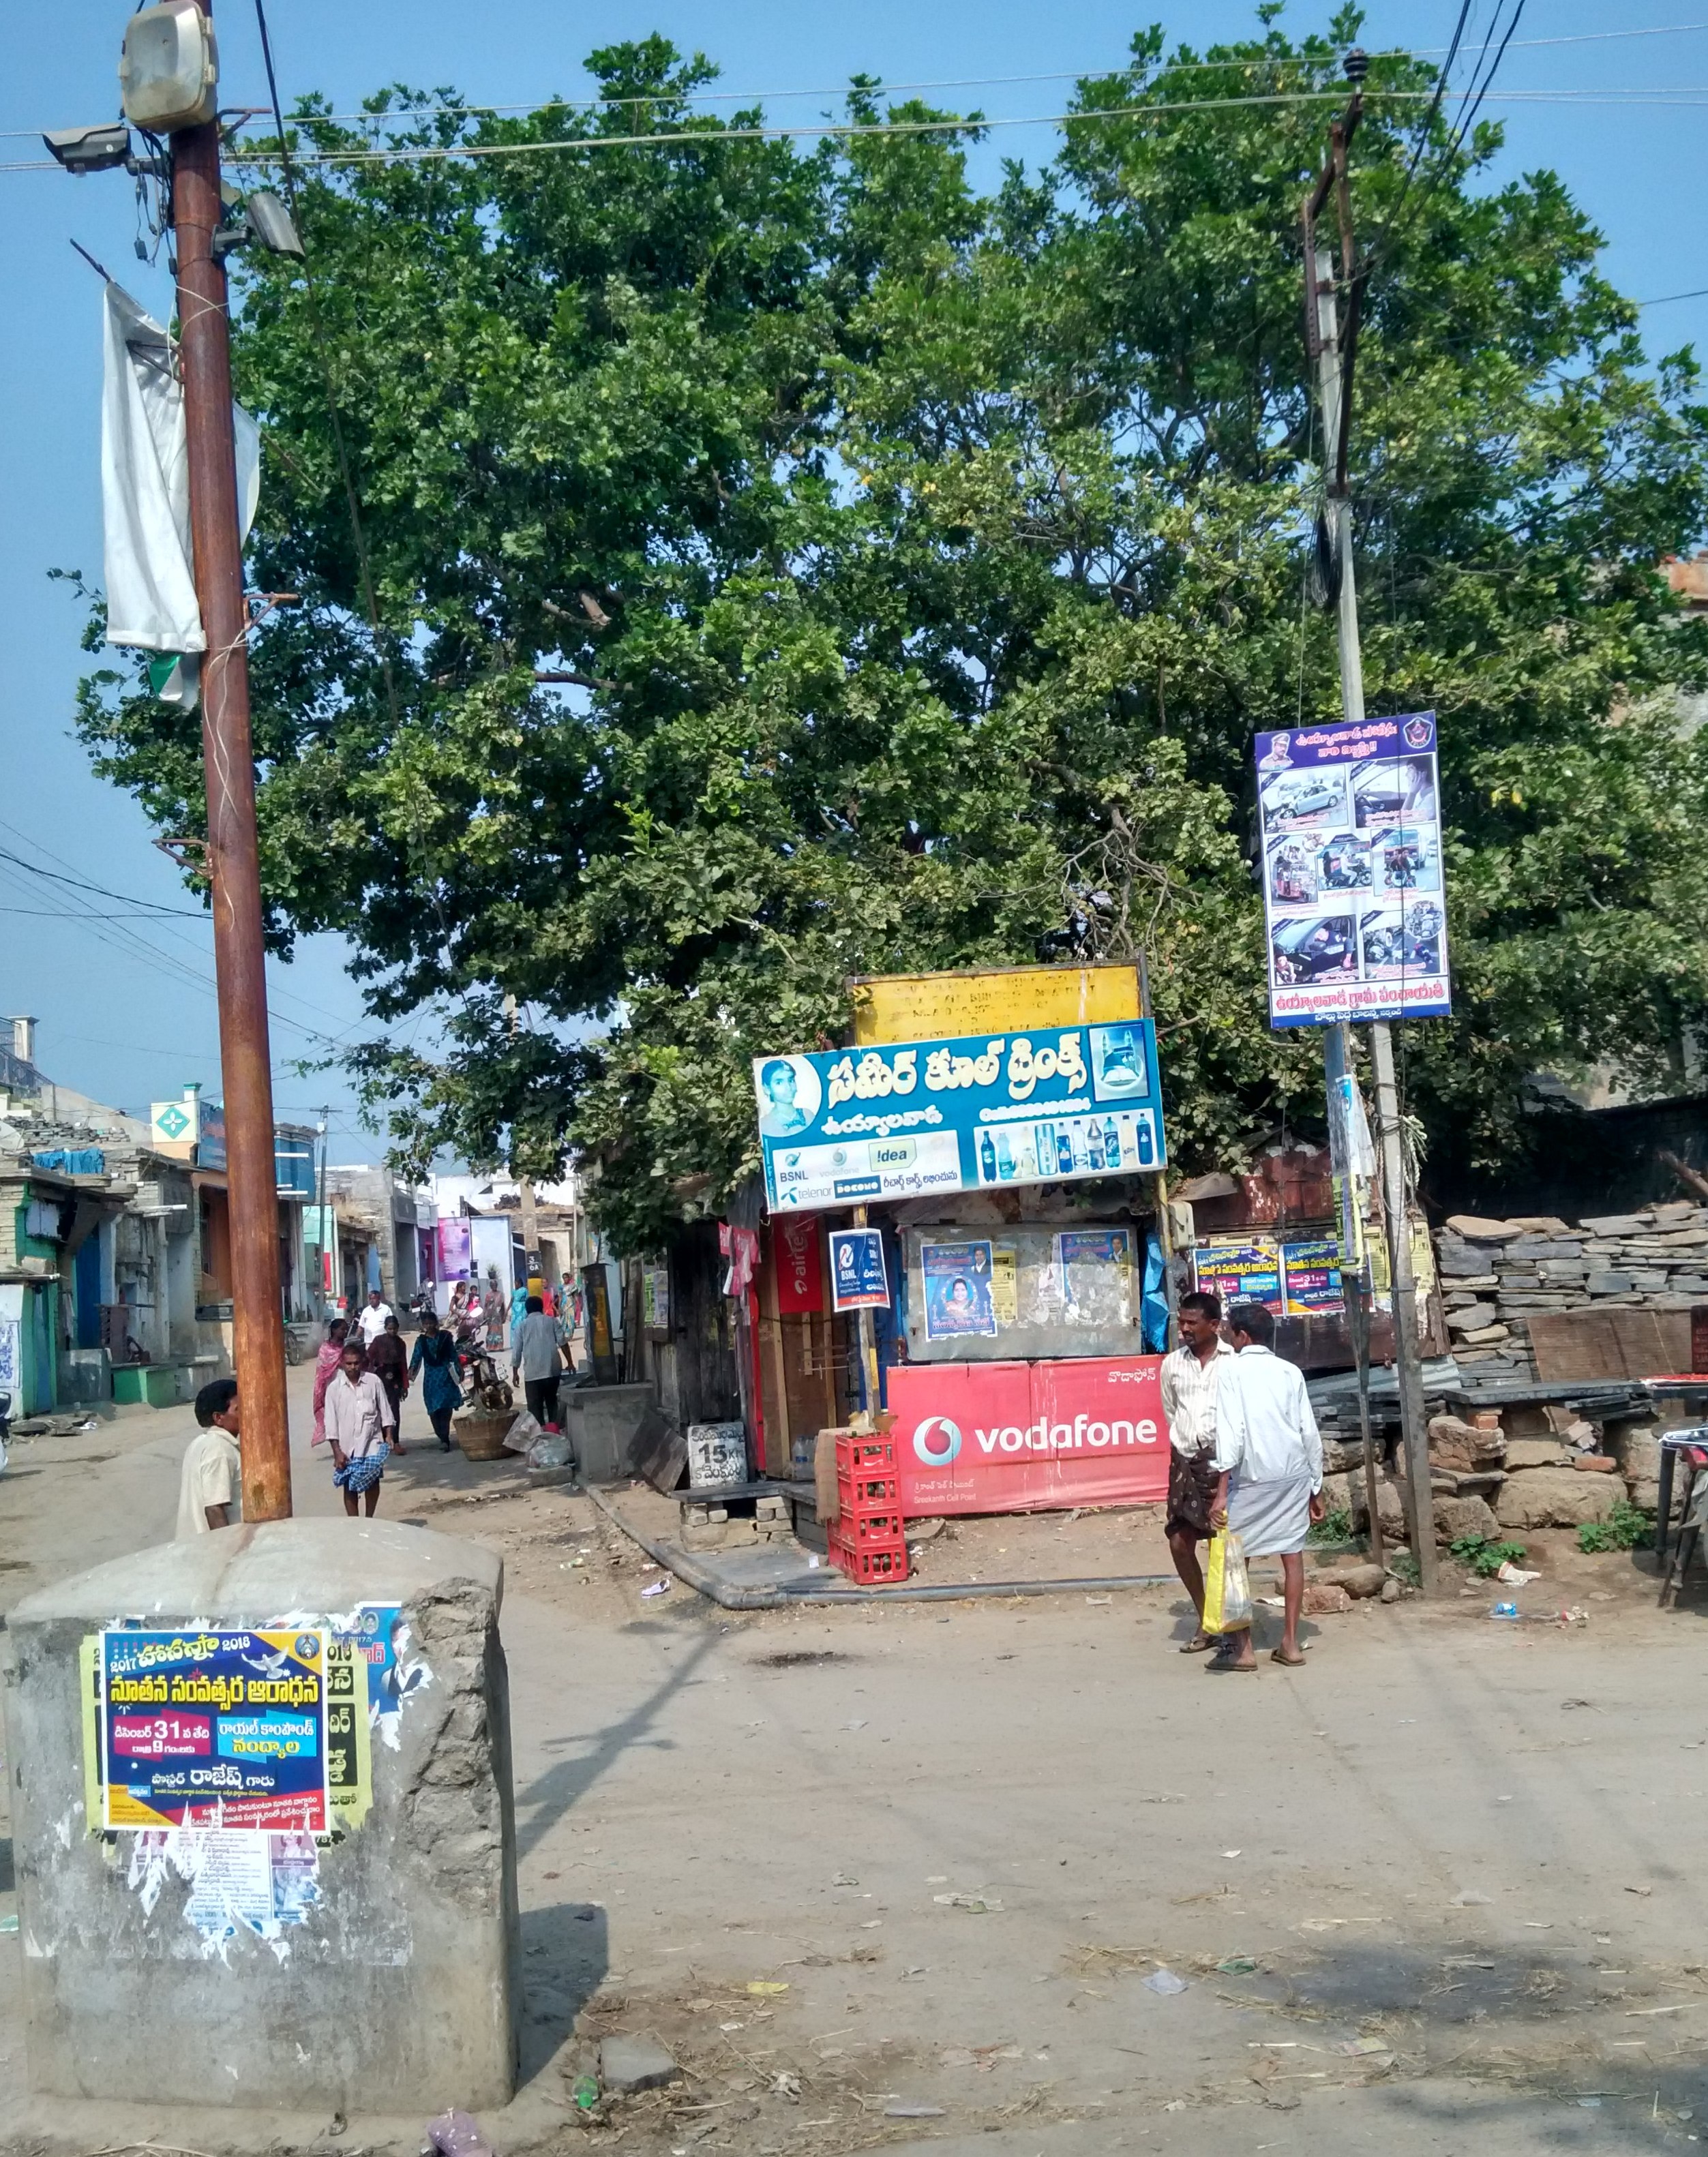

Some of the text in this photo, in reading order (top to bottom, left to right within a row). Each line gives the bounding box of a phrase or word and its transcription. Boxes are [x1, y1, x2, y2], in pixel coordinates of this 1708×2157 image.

[1276, 991, 1347, 1012] ఉయ్యాలవాడ
[1349, 987, 1377, 1008] గ్రామ
[826, 1048, 918, 1110] సమీర్
[924, 1038, 1006, 1092] కూల్
[821, 1104, 943, 1136] ఉయ్యాలవాడ
[780, 1171, 809, 1183] BSNL
[820, 1166, 859, 1177] vodafone
[798, 1187, 832, 1199] telenor
[837, 1181, 878, 1194] DOCOMO
[841, 1269, 857, 1280] BSNL
[975, 1414, 1157, 1453] vodafone
[699, 1443, 728, 1463] 15
[914, 1493, 976, 1504] Sreekanth Cell Point
[110, 1658, 136, 1673] 2017
[222, 1636, 250, 1652] 2018
[327, 1644, 352, 1661] 018
[110, 1675, 319, 1711] నూతన సంవత్సర ఆరాధన
[114, 1725, 152, 1739] డిసెంబర్
[154, 1721, 179, 1739] 31
[219, 1719, 258, 1736] రాయల్
[152, 1740, 163, 1753] 9
[233, 1738, 299, 1759] నంద్యాల
[190, 1764, 243, 1790] రాజేష్
[245, 1776, 275, 1787] గారు
